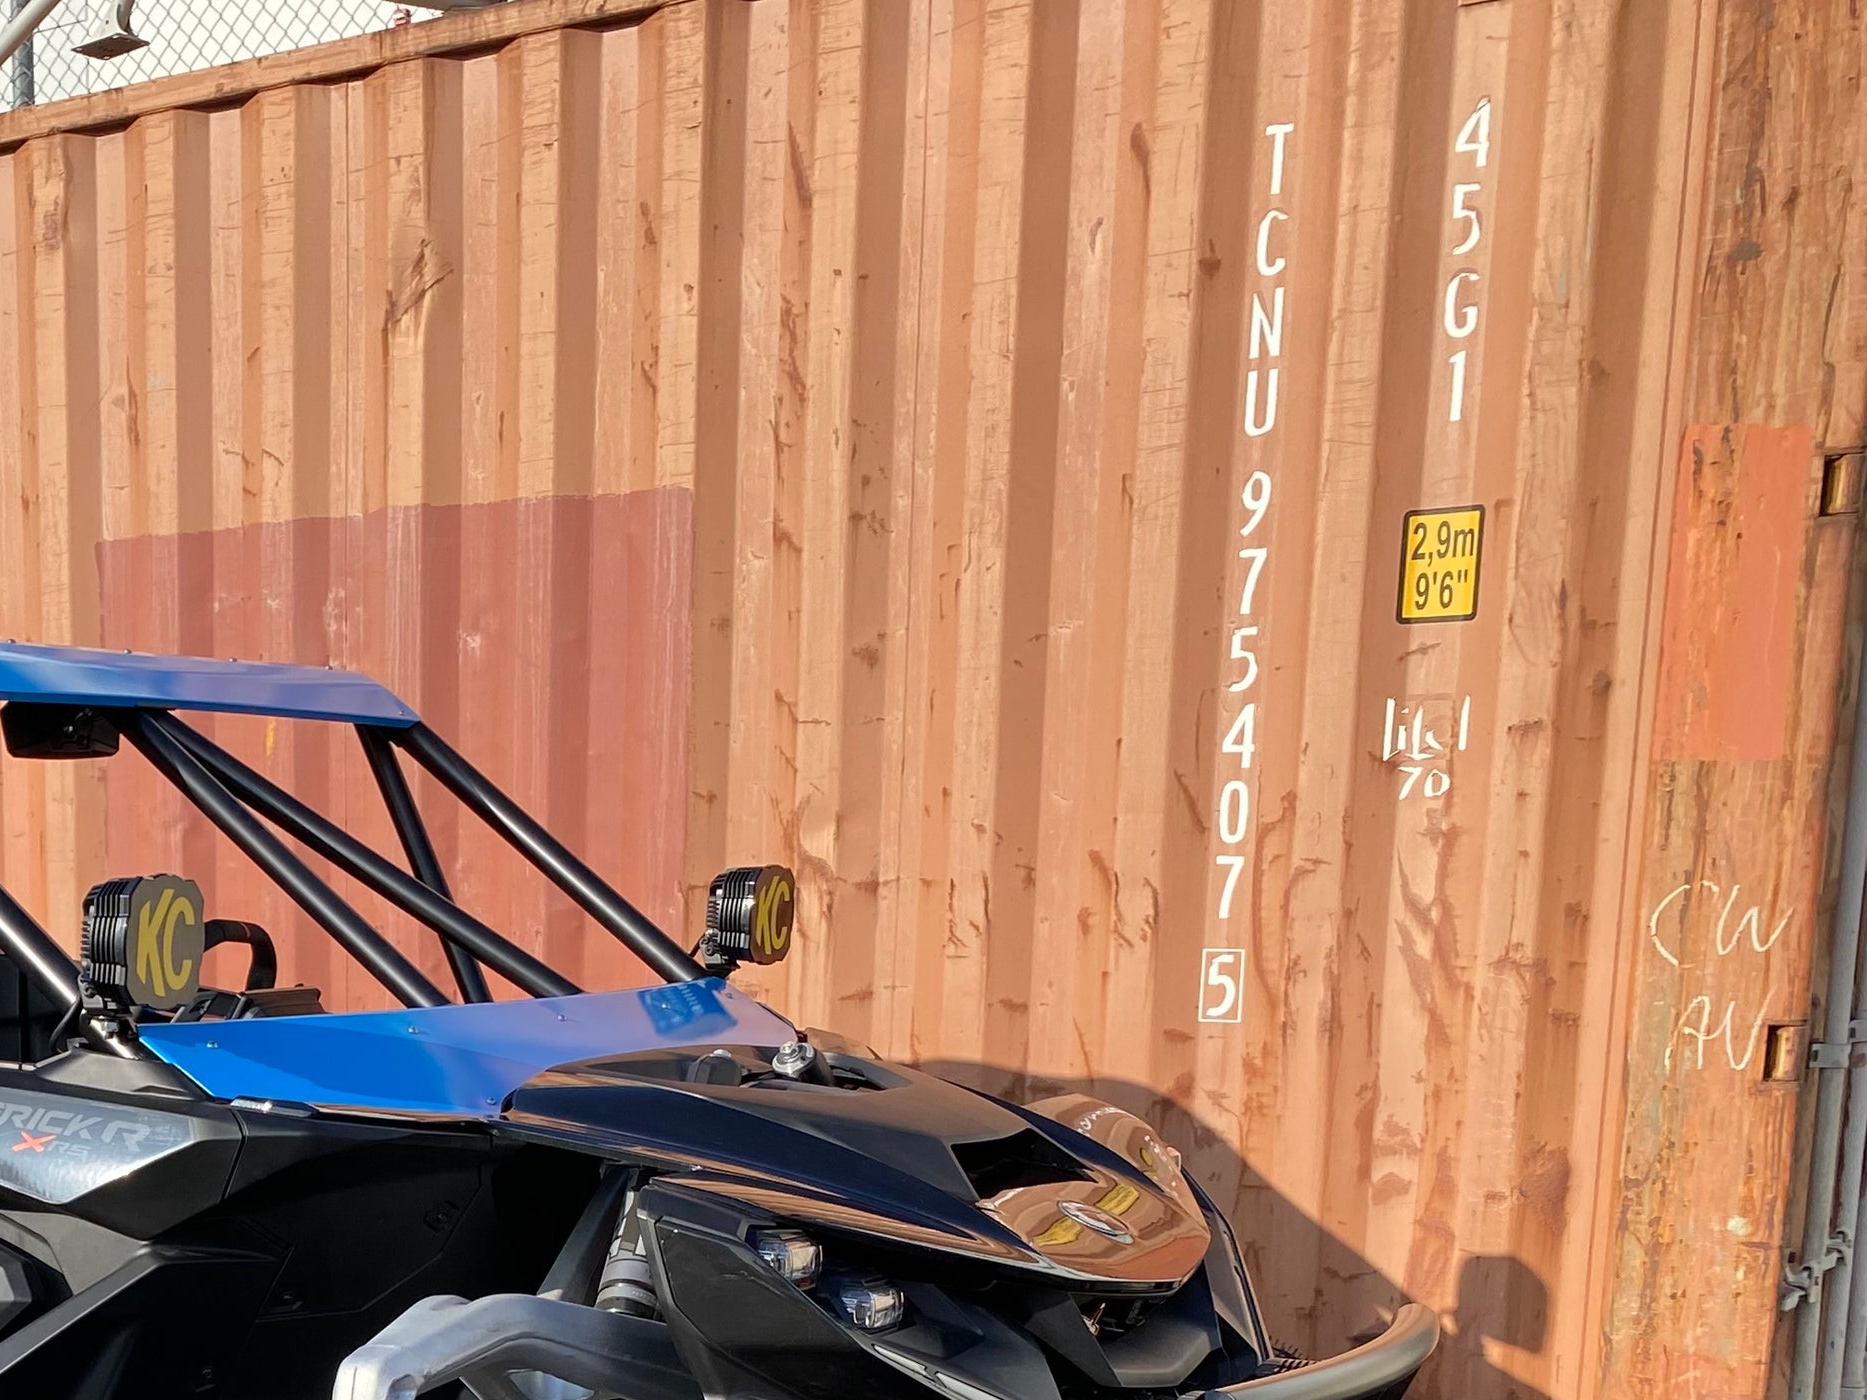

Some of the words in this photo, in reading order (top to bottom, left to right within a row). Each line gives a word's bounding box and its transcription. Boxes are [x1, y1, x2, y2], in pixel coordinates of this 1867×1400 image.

[1243, 122, 1294, 437] TCNU
[1444, 96, 1492, 422] 45G1
[1411, 520, 1475, 568] 2,9m
[1216, 470, 1272, 919] 975407
[136, 888, 196, 997] KC
[756, 875, 791, 955] KC
[1205, 953, 1237, 1017] 5
